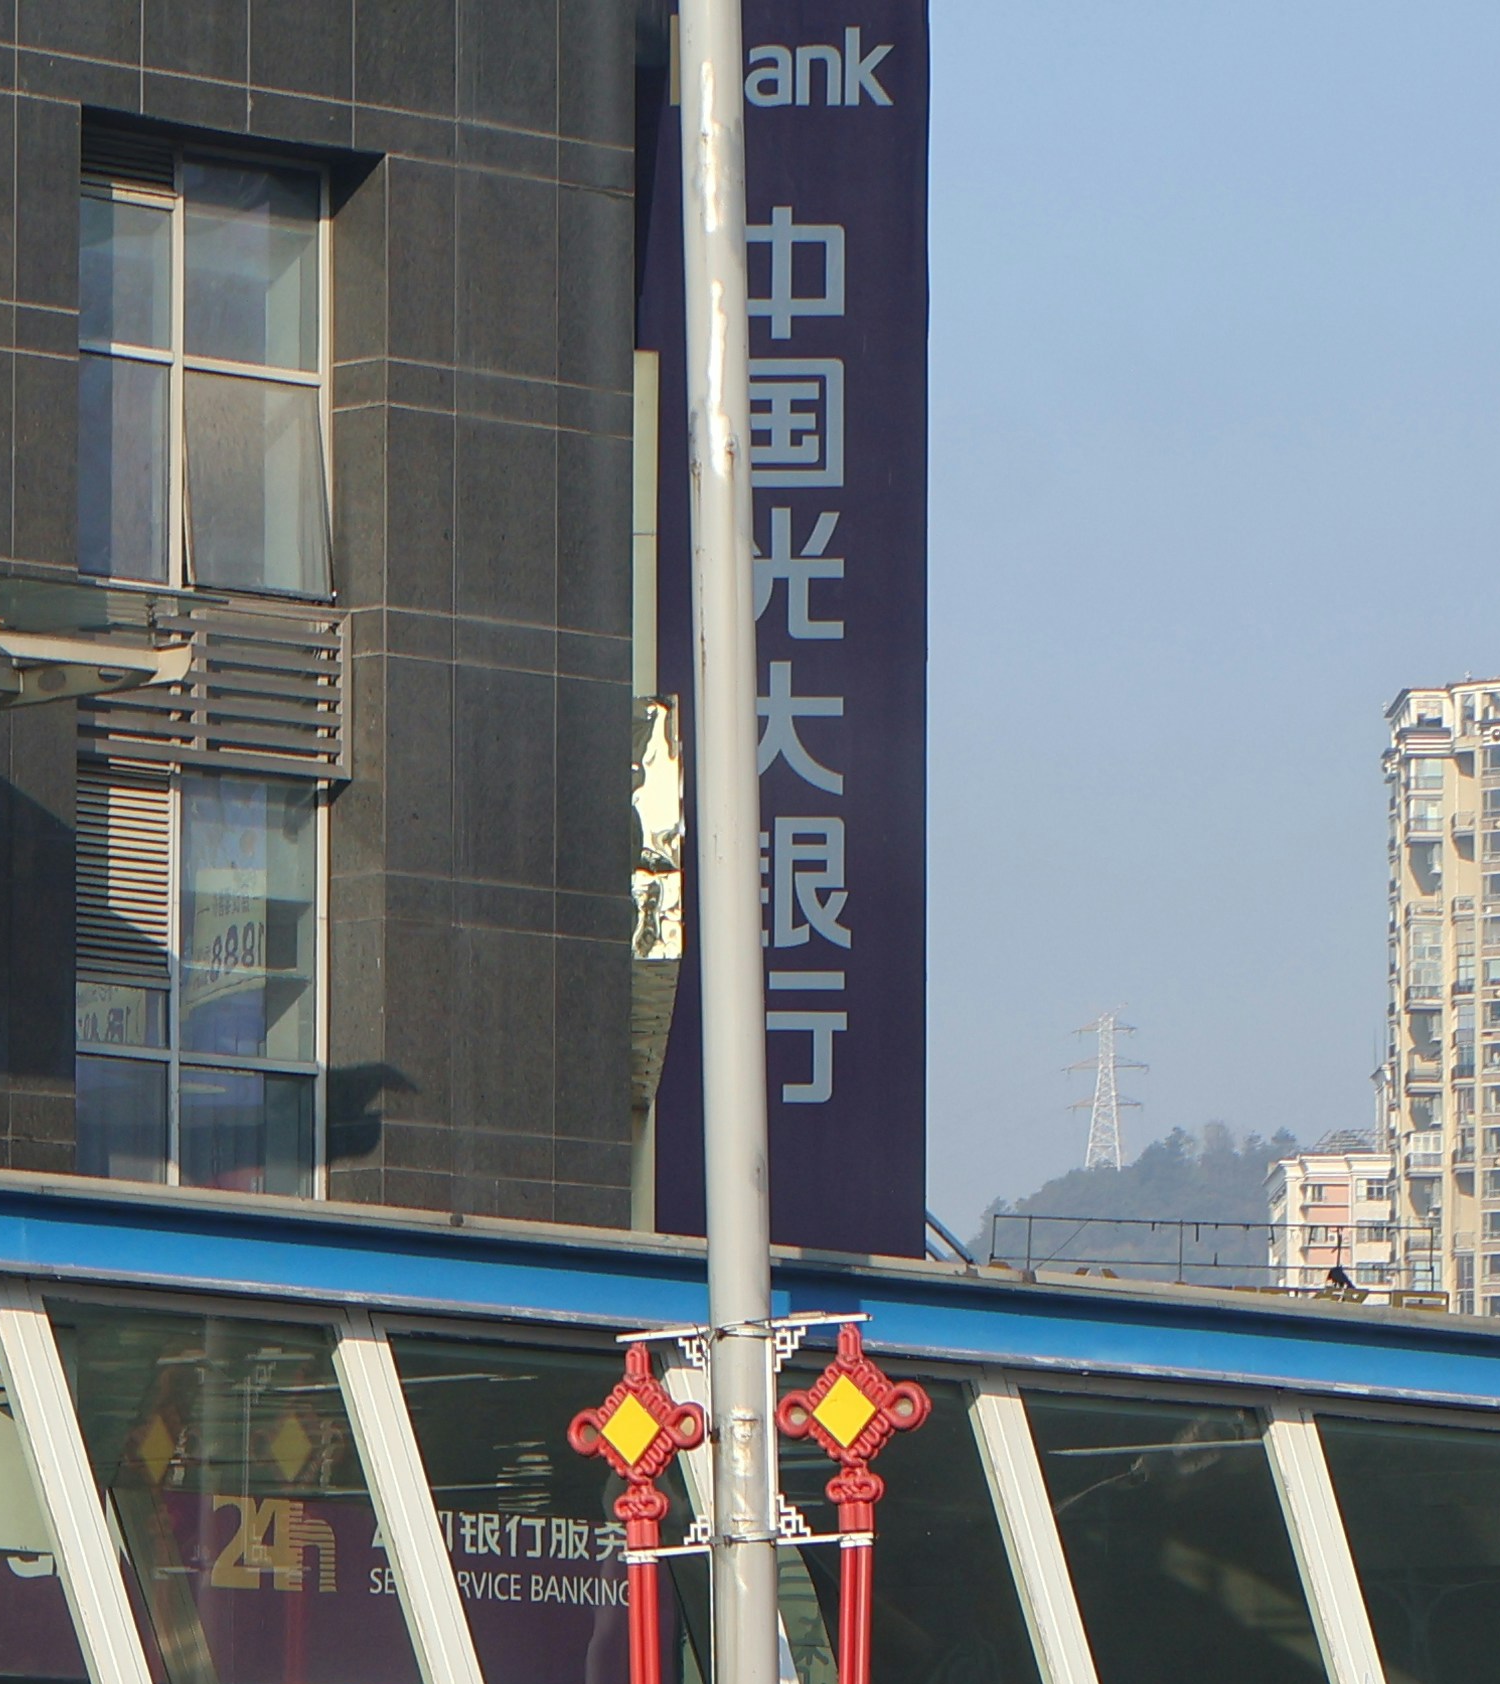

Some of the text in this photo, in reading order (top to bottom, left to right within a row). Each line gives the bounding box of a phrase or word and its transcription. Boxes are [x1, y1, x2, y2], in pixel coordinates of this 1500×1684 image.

[746, 206, 853, 1104] 中国光大银行
[210, 1495, 337, 1592] 24h
[531, 1576, 630, 1607] BANKING
